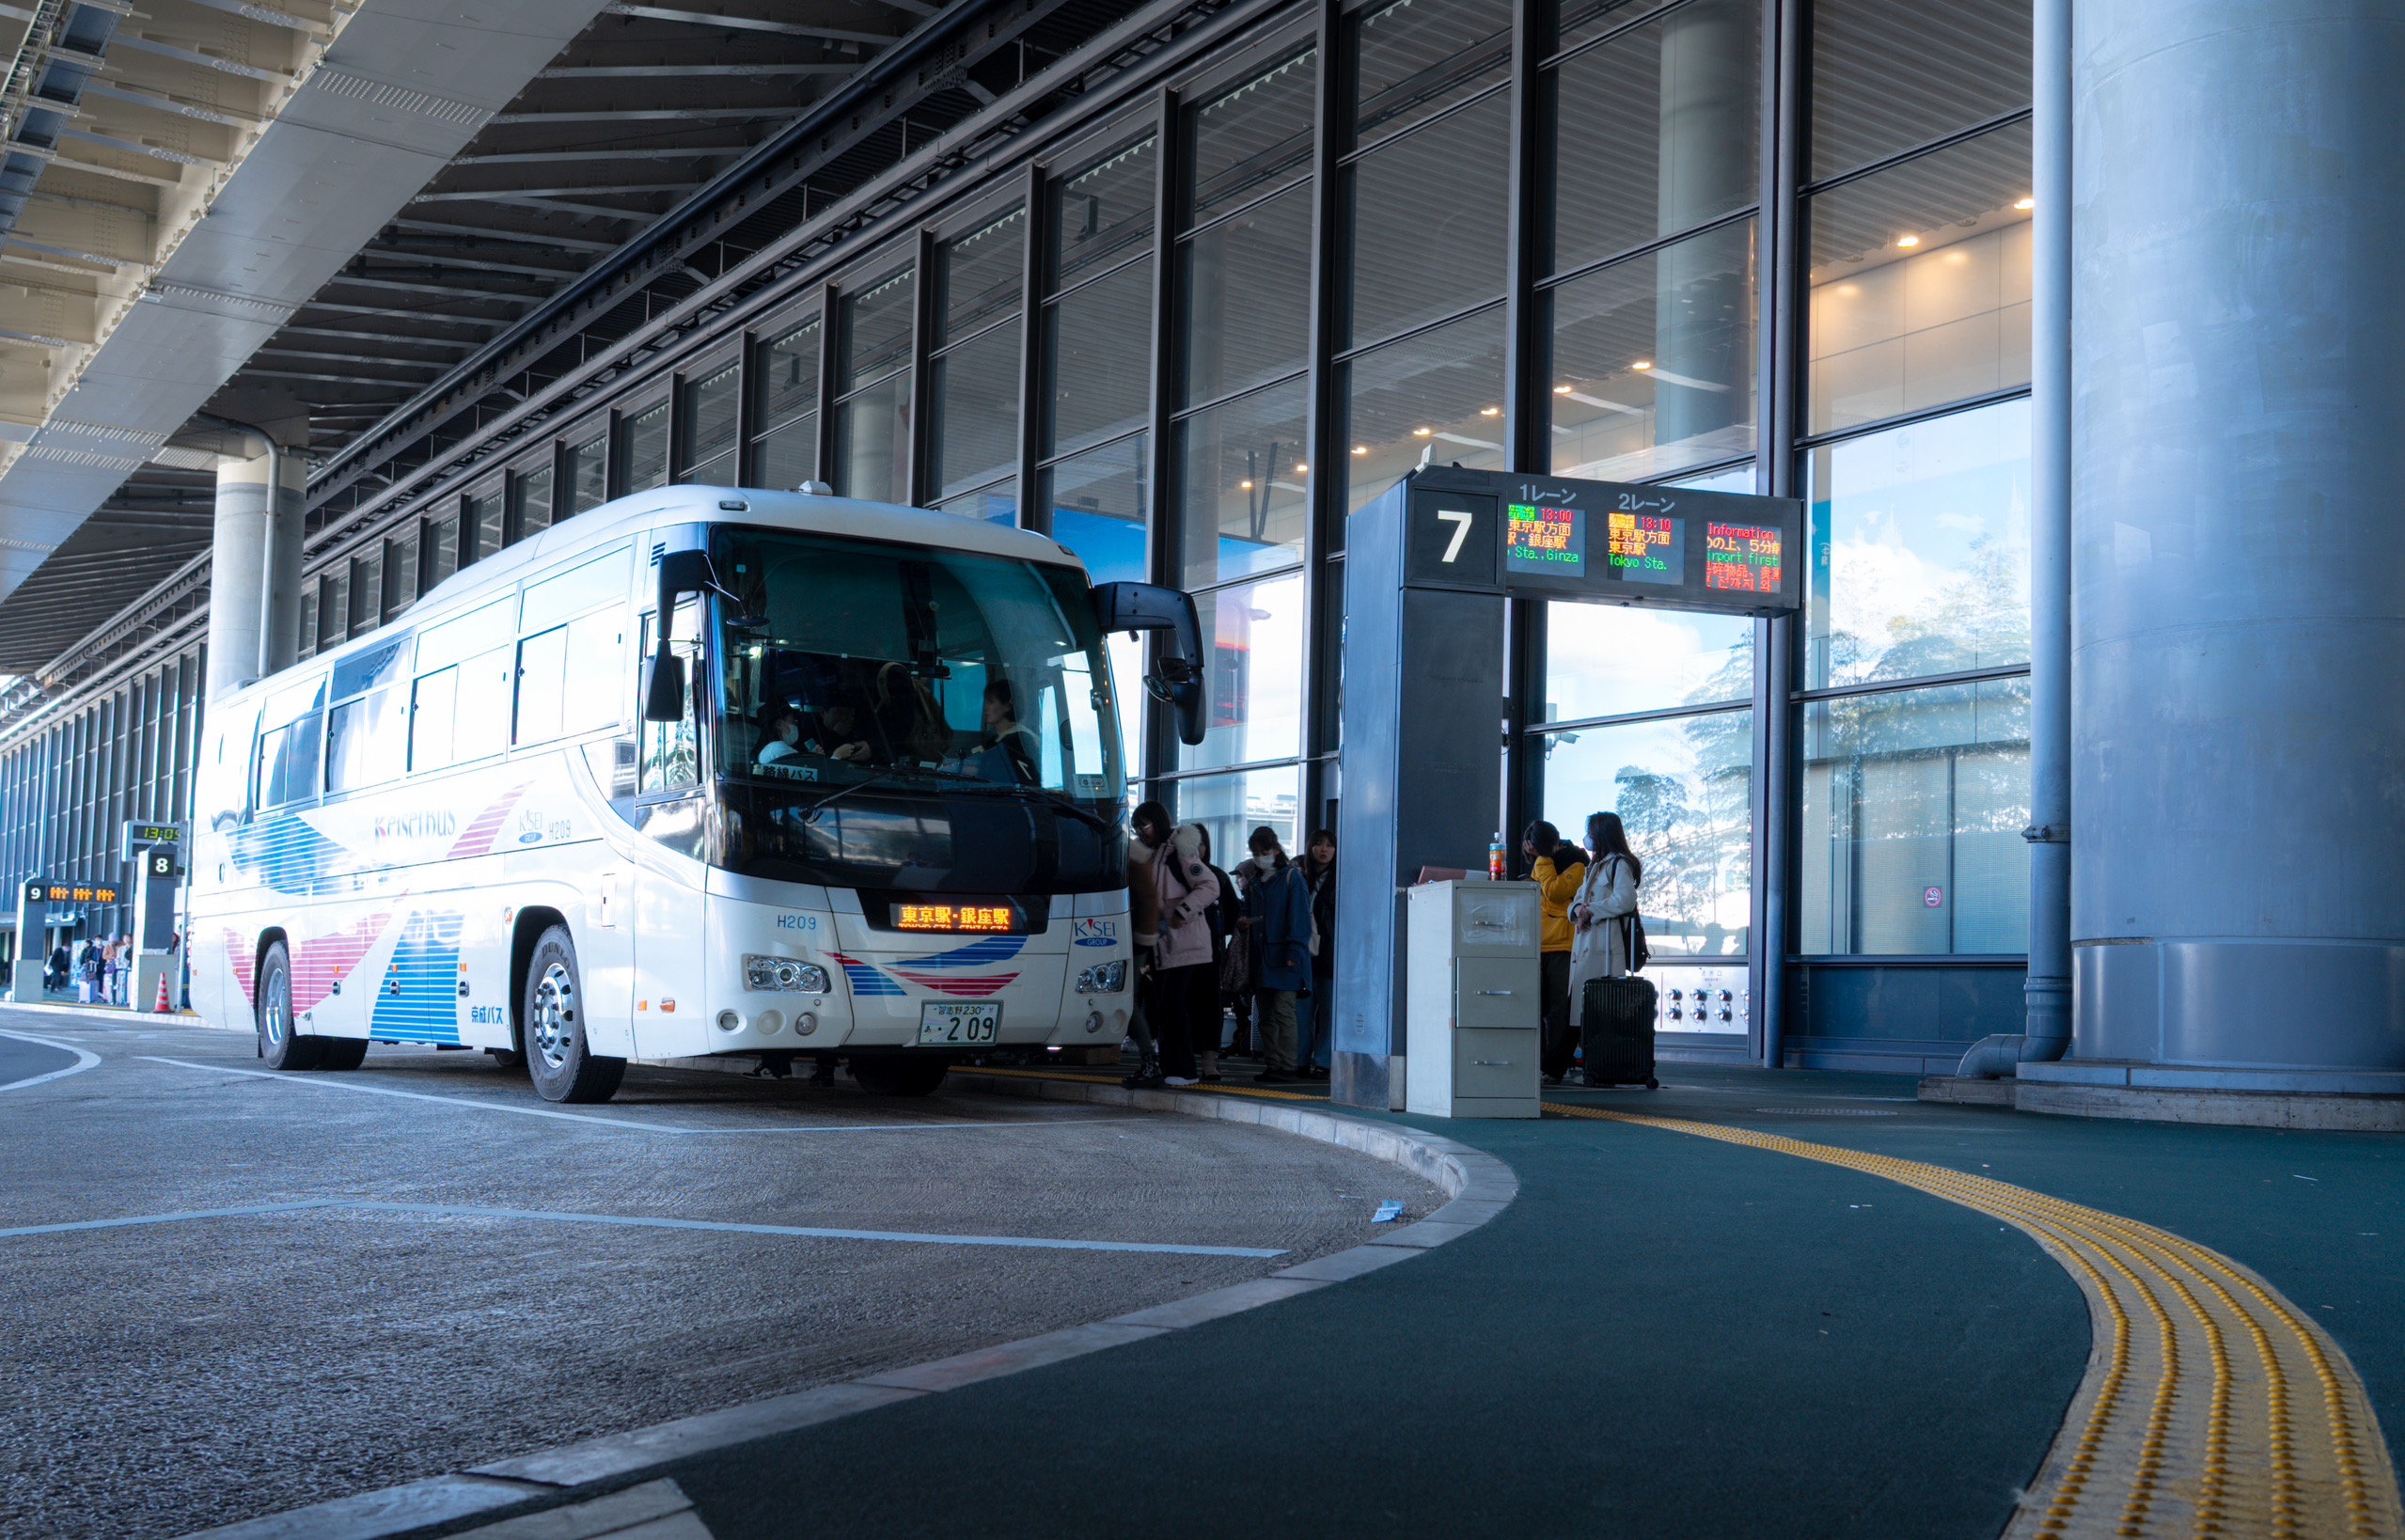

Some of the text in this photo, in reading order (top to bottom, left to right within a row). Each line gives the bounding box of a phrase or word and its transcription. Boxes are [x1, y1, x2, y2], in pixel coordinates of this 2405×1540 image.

[1519, 484, 1578, 504] 1レーン
[1618, 493, 1675, 513] 2レーン
[1541, 508, 1573, 524] 13:00
[1642, 516, 1672, 531] 13:10
[1438, 510, 1472, 563] 7
[1508, 519, 1572, 537] 東京駅方面
[1609, 527, 1671, 545] 東京駅方面
[1708, 523, 1775, 540] Information
[1609, 542, 1646, 556] 東京駅
[1609, 553, 1667, 570] Tokyo Sta.
[1749, 552, 1779, 567] first
[763, 765, 816, 781] 路線バス
[549, 819, 572, 841] H209
[155, 857, 168, 872] 8
[30, 888, 41, 900] 9
[778, 915, 816, 930] H209
[901, 906, 1010, 924] 東京駅・銀座駅
[471, 1005, 503, 1024] 京成バス
